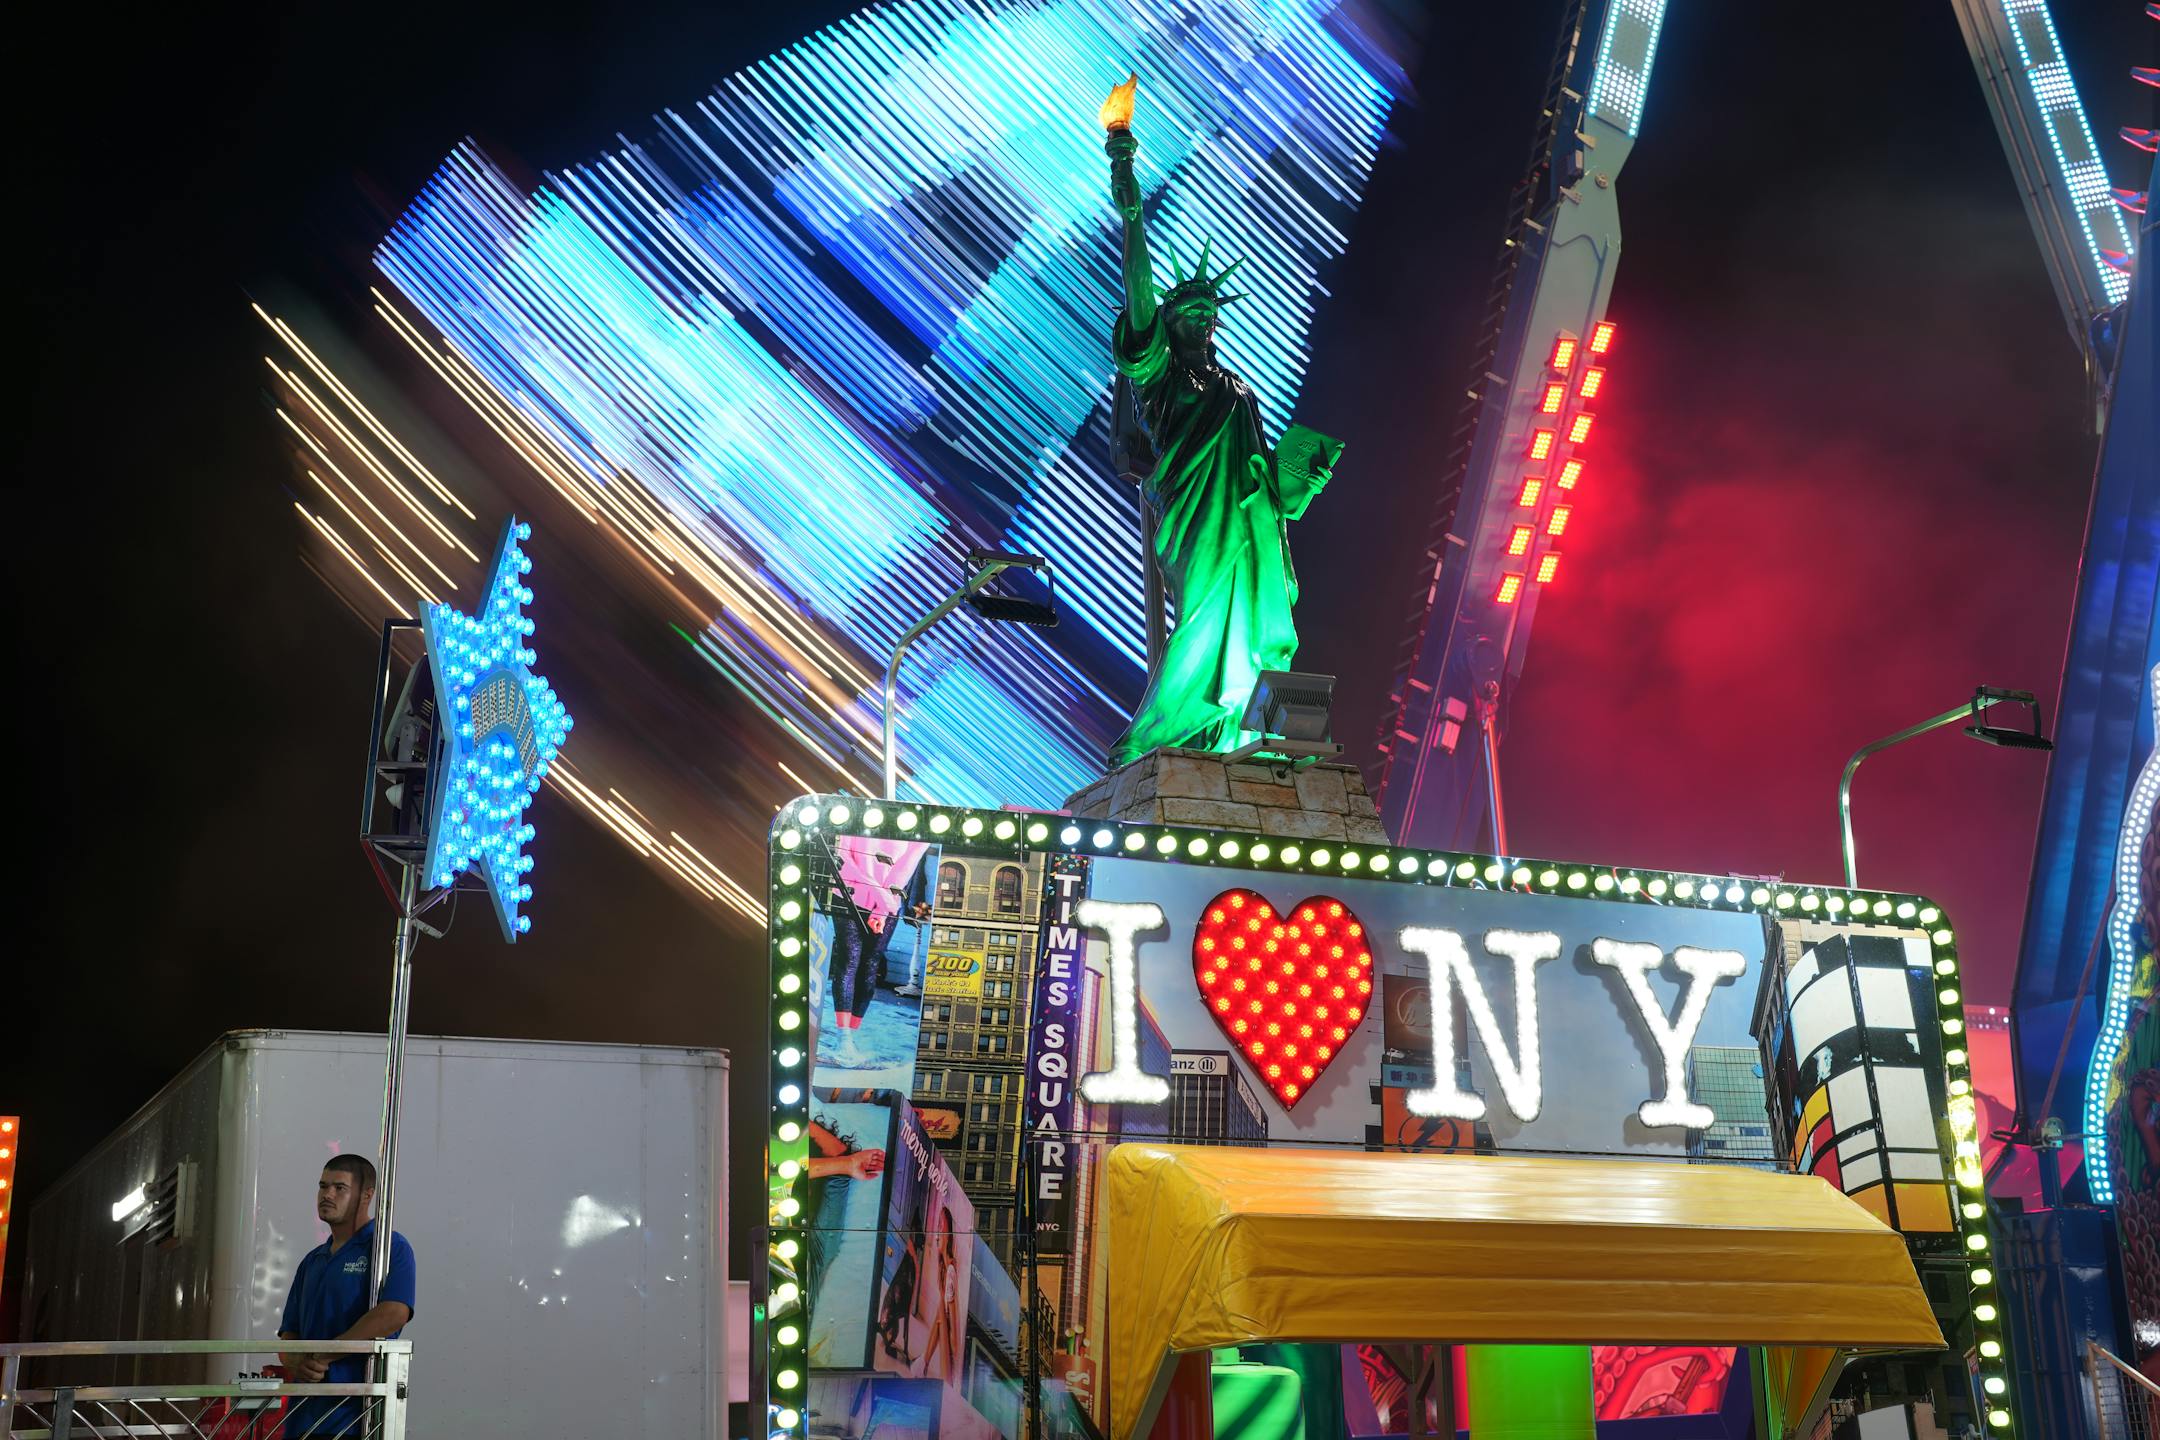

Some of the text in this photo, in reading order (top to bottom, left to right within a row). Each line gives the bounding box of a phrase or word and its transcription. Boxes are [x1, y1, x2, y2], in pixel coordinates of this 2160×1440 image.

[1033, 874, 1081, 1199] TIMES SQUARE
[1075, 900, 1168, 1103] I
[1398, 926, 1746, 1130] NY
[1037, 1222, 1060, 1231] NYC
